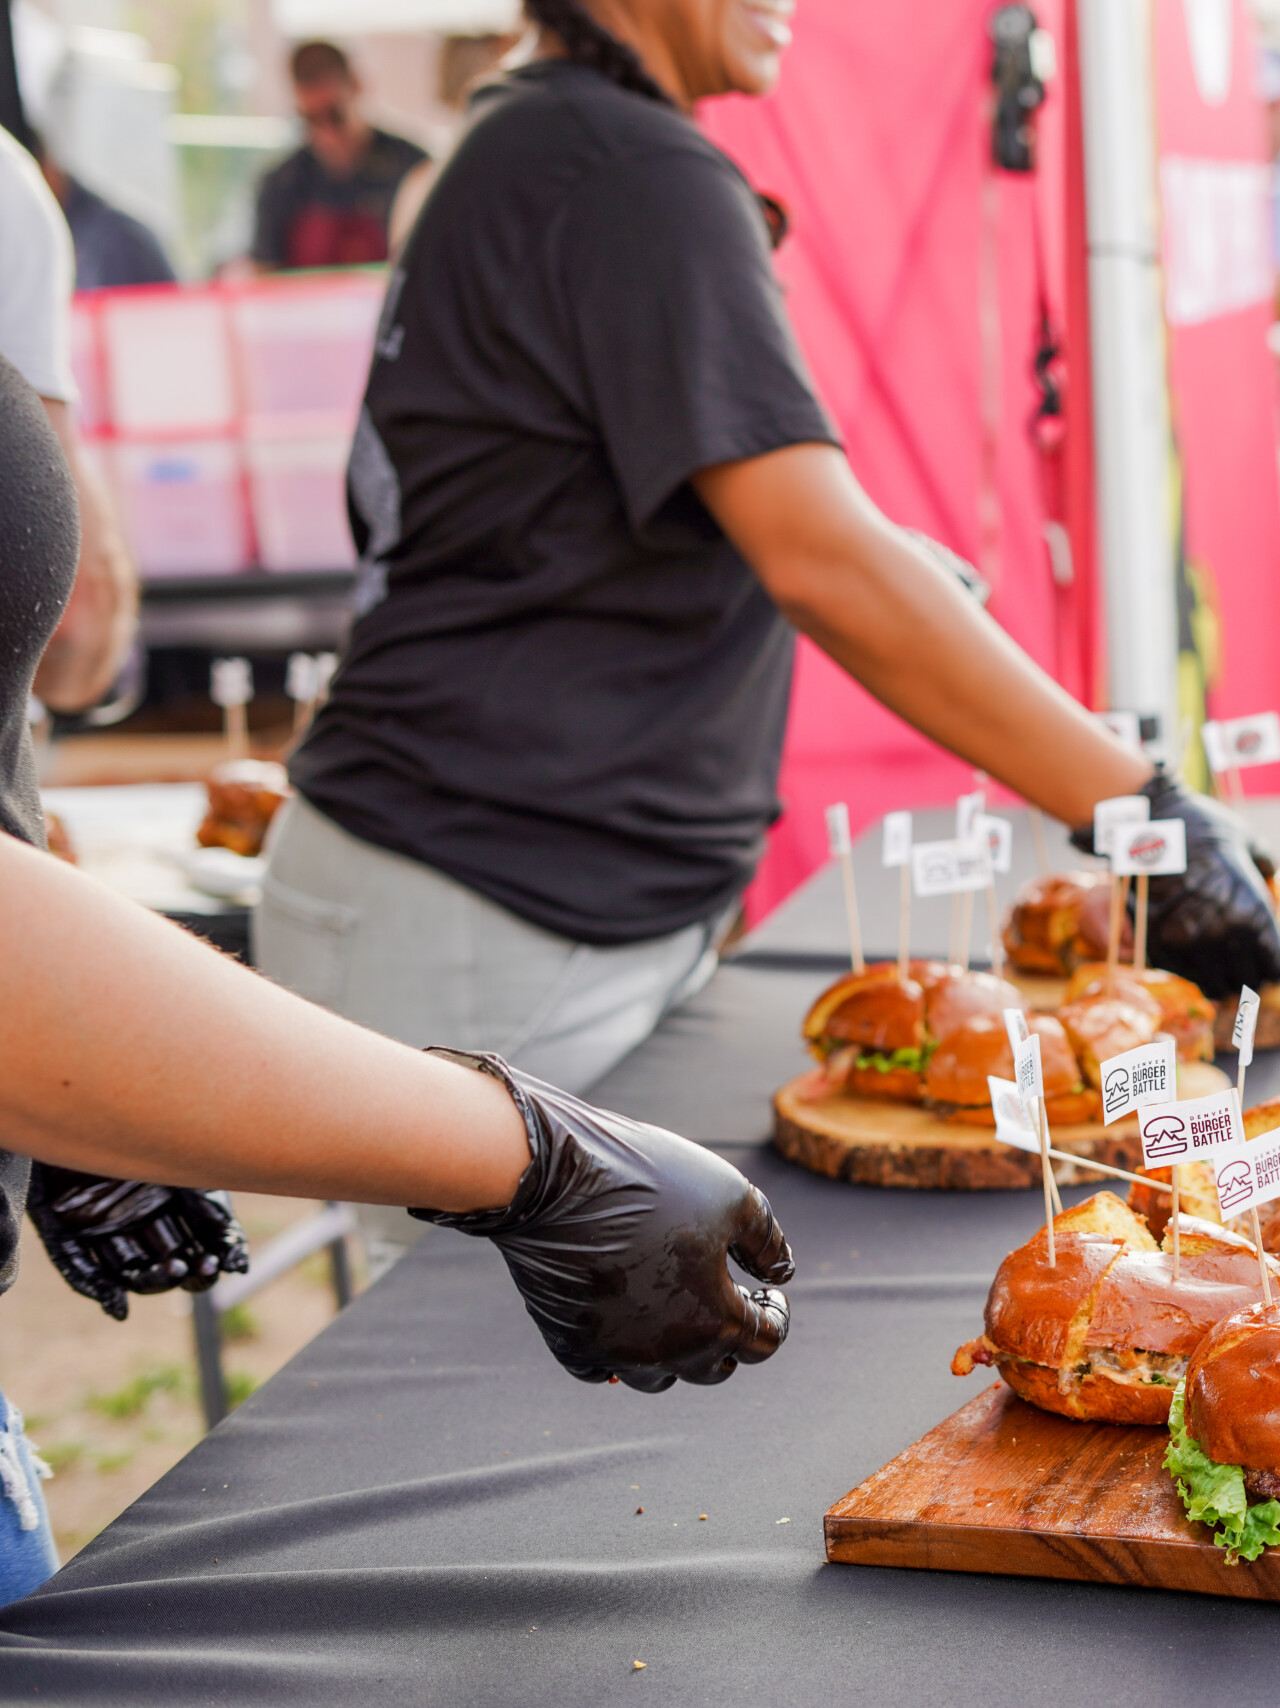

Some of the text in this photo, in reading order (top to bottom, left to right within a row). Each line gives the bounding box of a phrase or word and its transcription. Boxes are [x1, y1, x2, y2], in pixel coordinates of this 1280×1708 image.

[1132, 1058, 1166, 1070] DENVER
[1132, 1065, 1166, 1084] BURGER
[1133, 1078, 1166, 1097] BATTLE
[1190, 1107, 1229, 1121] DENVER
[1191, 1114, 1231, 1135] BURGER
[1193, 1127, 1233, 1148] BATTLE
